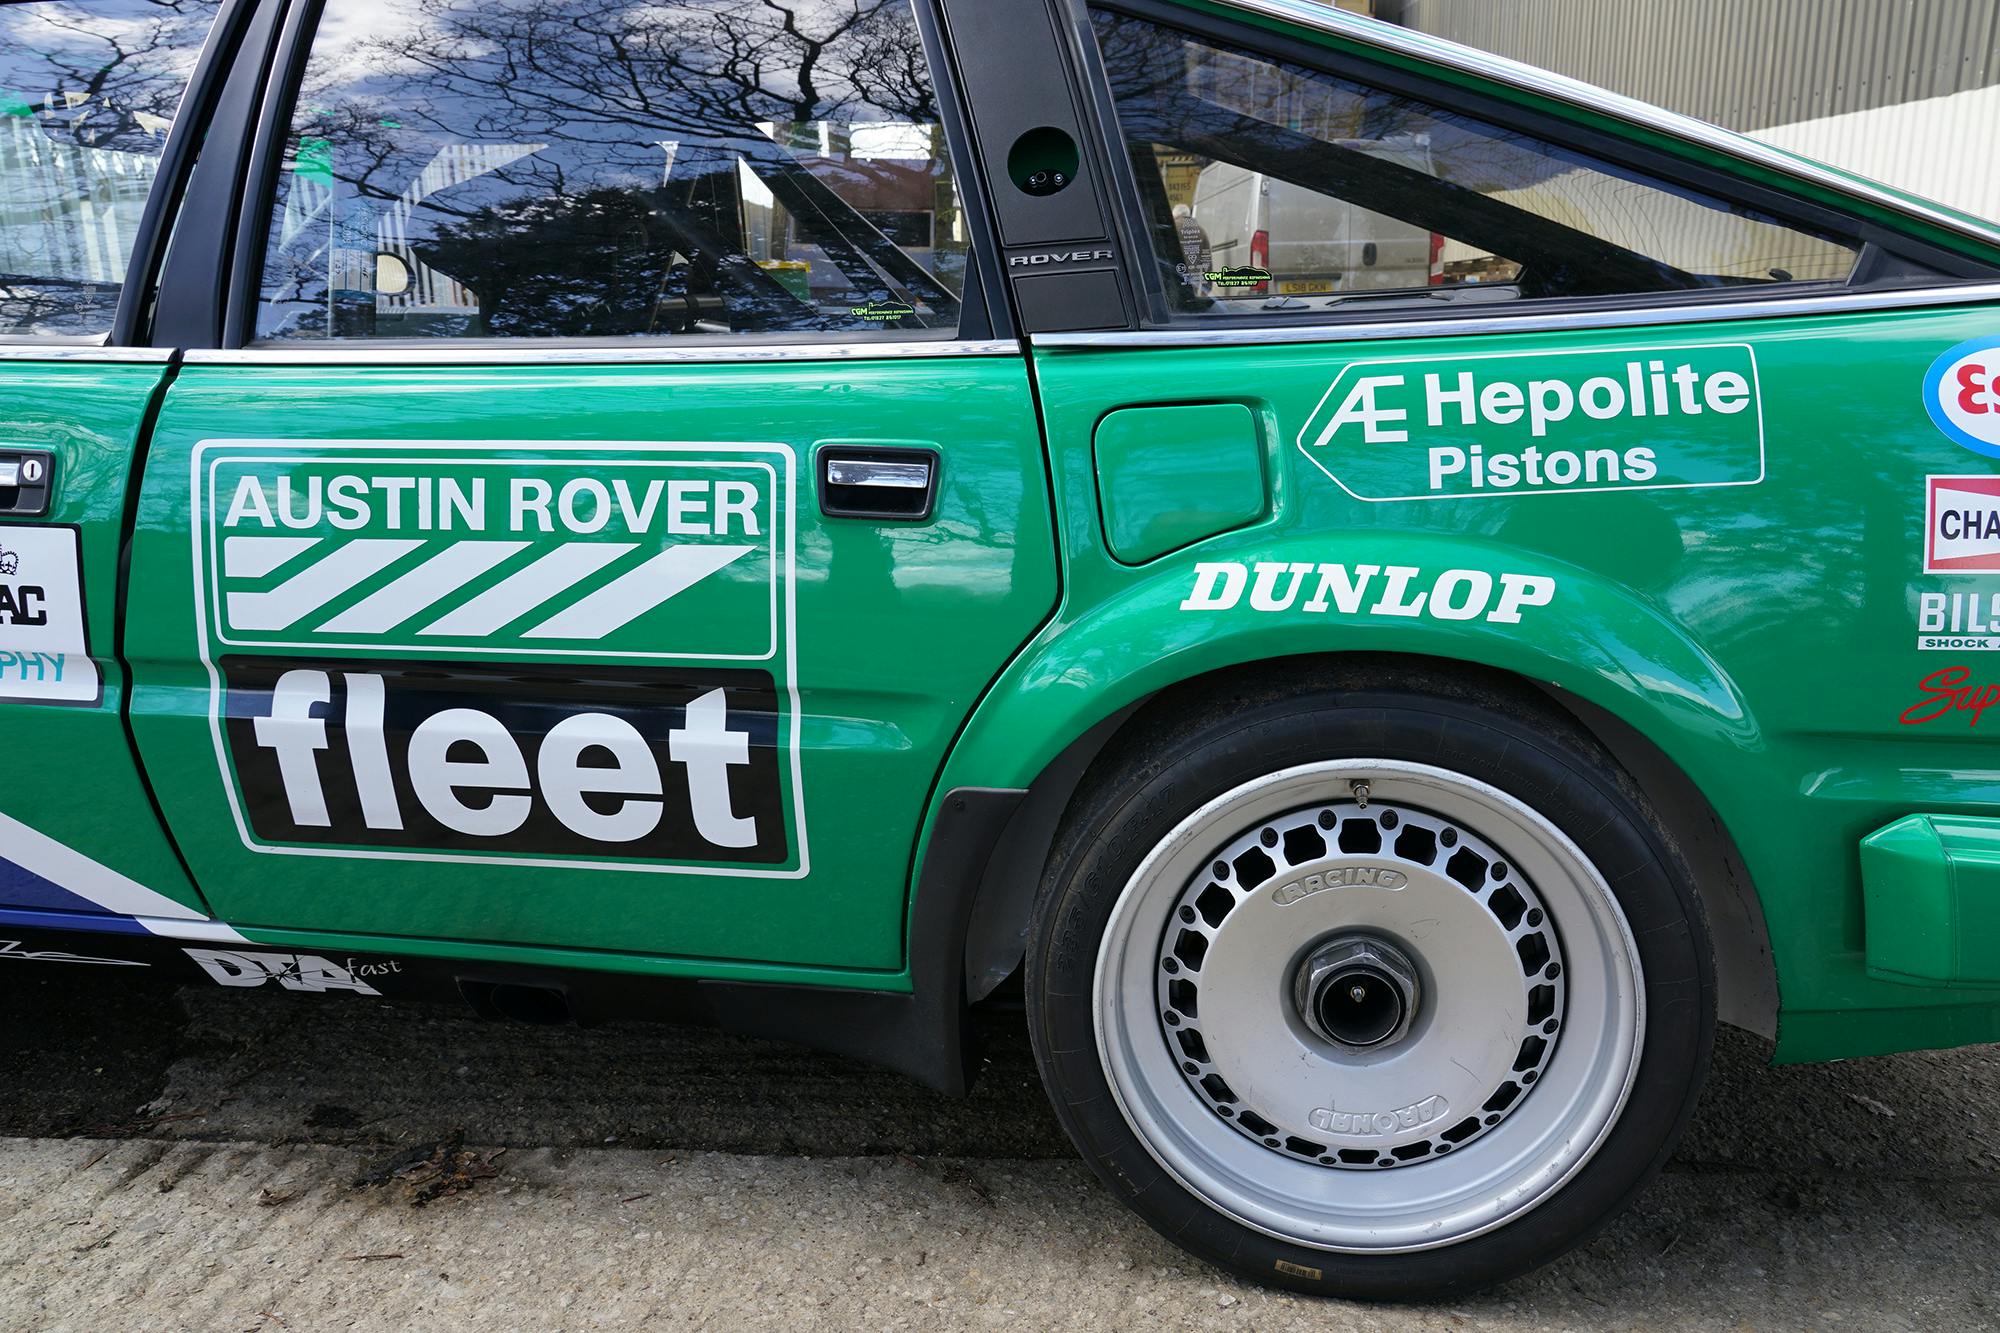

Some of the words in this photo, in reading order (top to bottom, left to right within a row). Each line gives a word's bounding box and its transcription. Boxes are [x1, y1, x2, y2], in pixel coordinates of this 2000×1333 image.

[1010, 250, 1113, 266] ROVER
[851, 307, 868, 316] CGM
[1424, 359, 1750, 437] Hepolite
[1428, 445, 1659, 490] Pistons
[223, 475, 485, 531] AUSTIN
[510, 477, 761, 536] ROVER
[1179, 561, 1556, 624] DUNLOP
[1925, 639, 1989, 648] SHOCK
[253, 669, 759, 850] fleet
[1283, 867, 1397, 903] RACING
